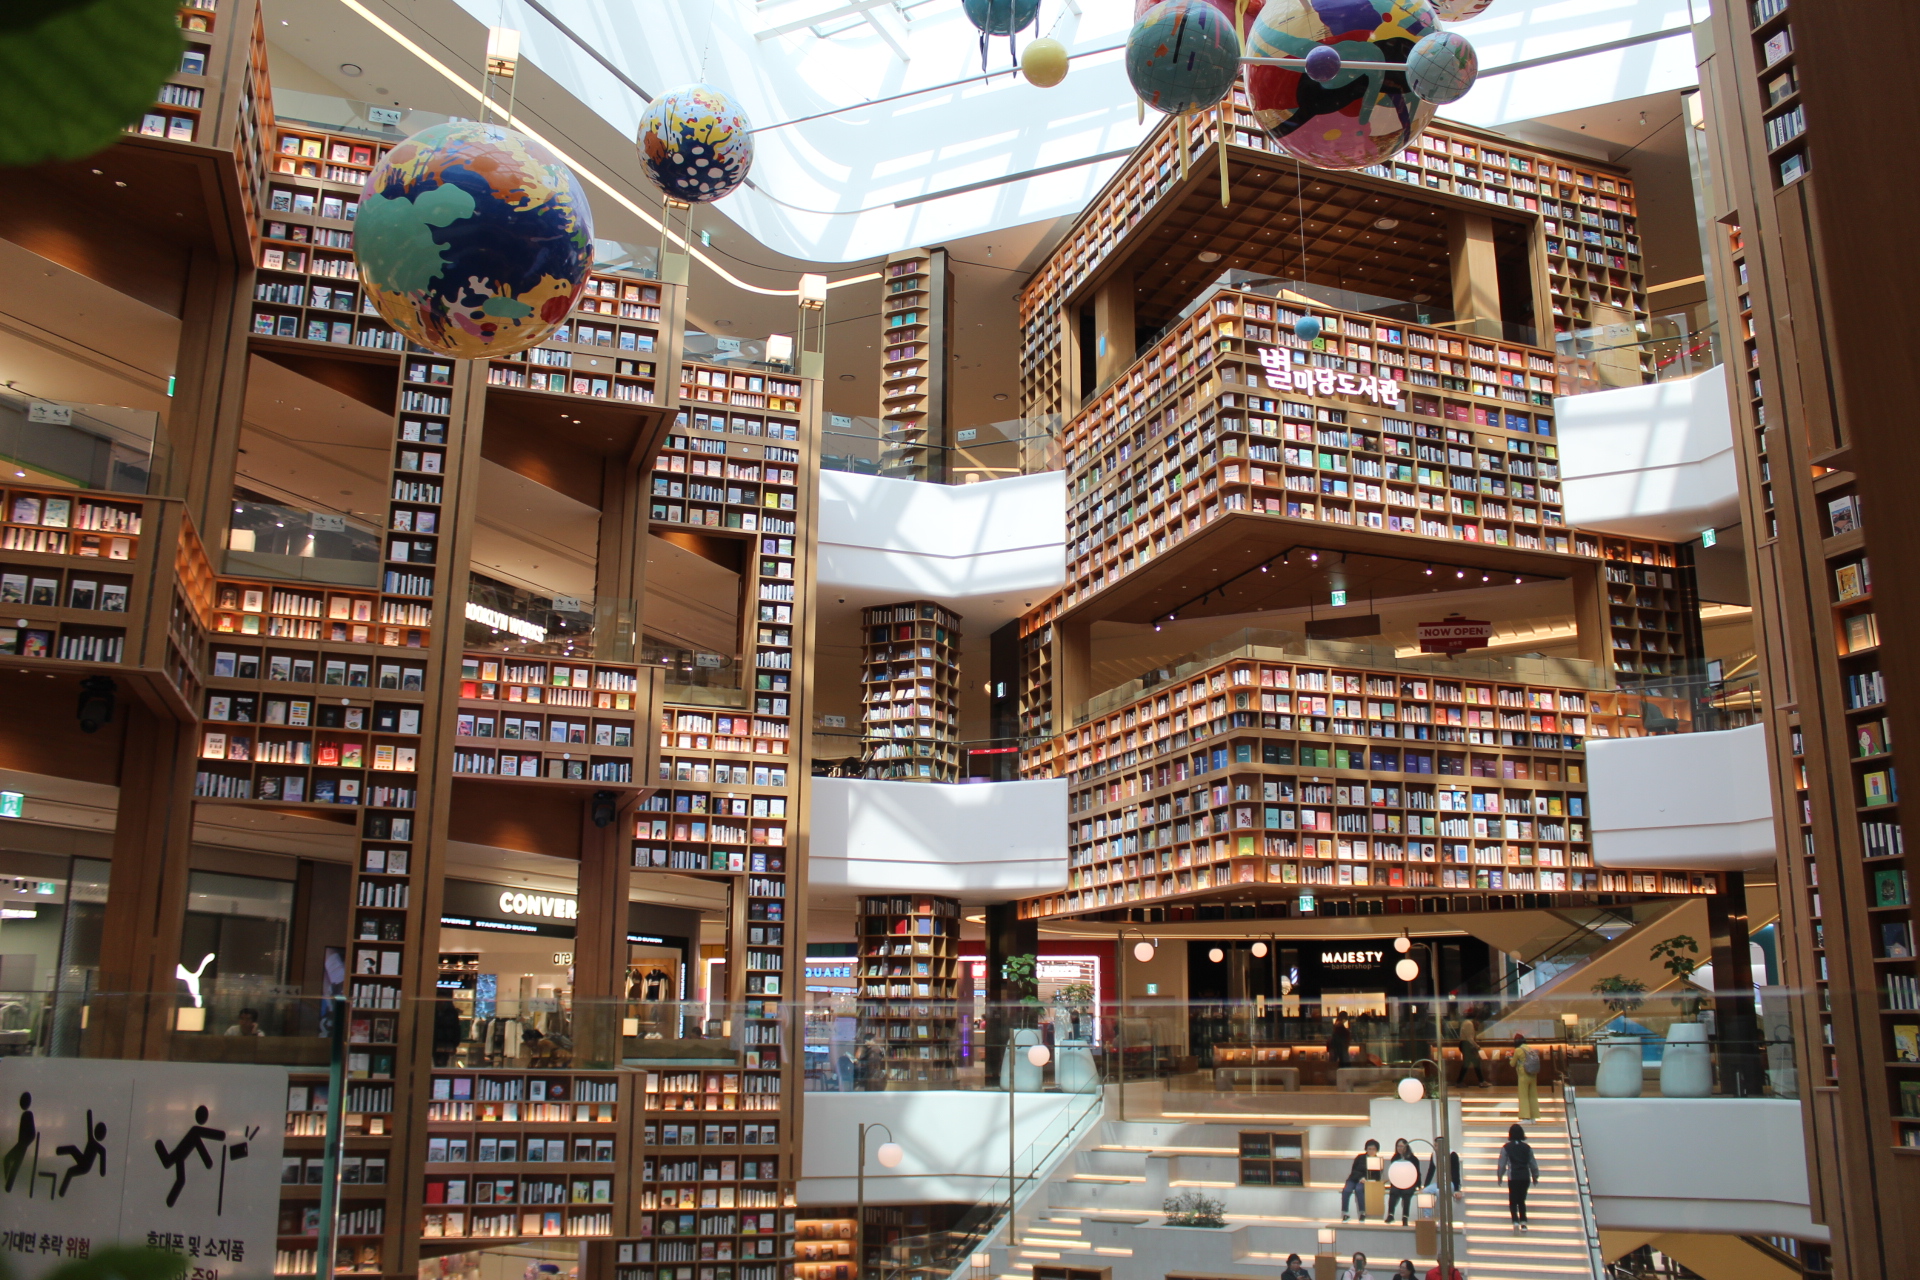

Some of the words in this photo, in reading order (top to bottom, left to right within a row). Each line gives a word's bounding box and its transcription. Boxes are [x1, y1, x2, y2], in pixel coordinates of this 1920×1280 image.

[1258, 347, 1401, 406] 별마당도서관
[509, 616, 544, 643] WORKS
[1424, 628, 1451, 637] NOW
[1454, 627, 1483, 636] OPEN
[475, 921, 511, 930] STARFIELD
[1322, 951, 1383, 963] MAJESTY
[1, 1231, 36, 1253] 기대면
[39, 1234, 63, 1256] 추락
[66, 1237, 90, 1260] 위험
[188, 1236, 201, 1258] 및
[204, 1238, 245, 1262] 소지품
